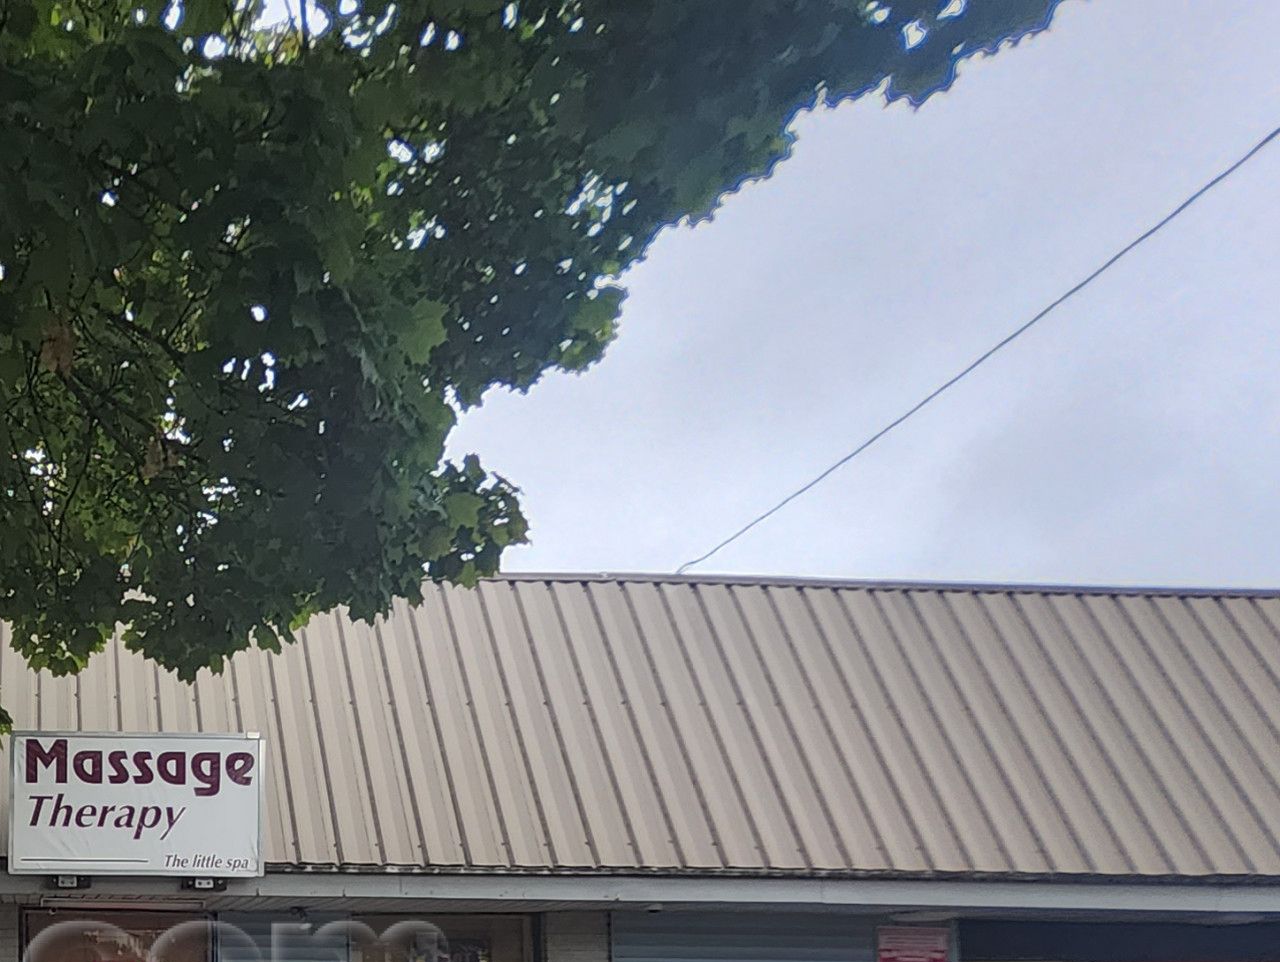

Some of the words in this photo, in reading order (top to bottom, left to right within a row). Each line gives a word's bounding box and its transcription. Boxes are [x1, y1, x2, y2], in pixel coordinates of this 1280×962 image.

[25, 738, 255, 797] Massage
[28, 793, 186, 840] Therapy
[164, 854, 189, 868] The
[192, 854, 222, 869] little
[225, 858, 249, 872] spa
